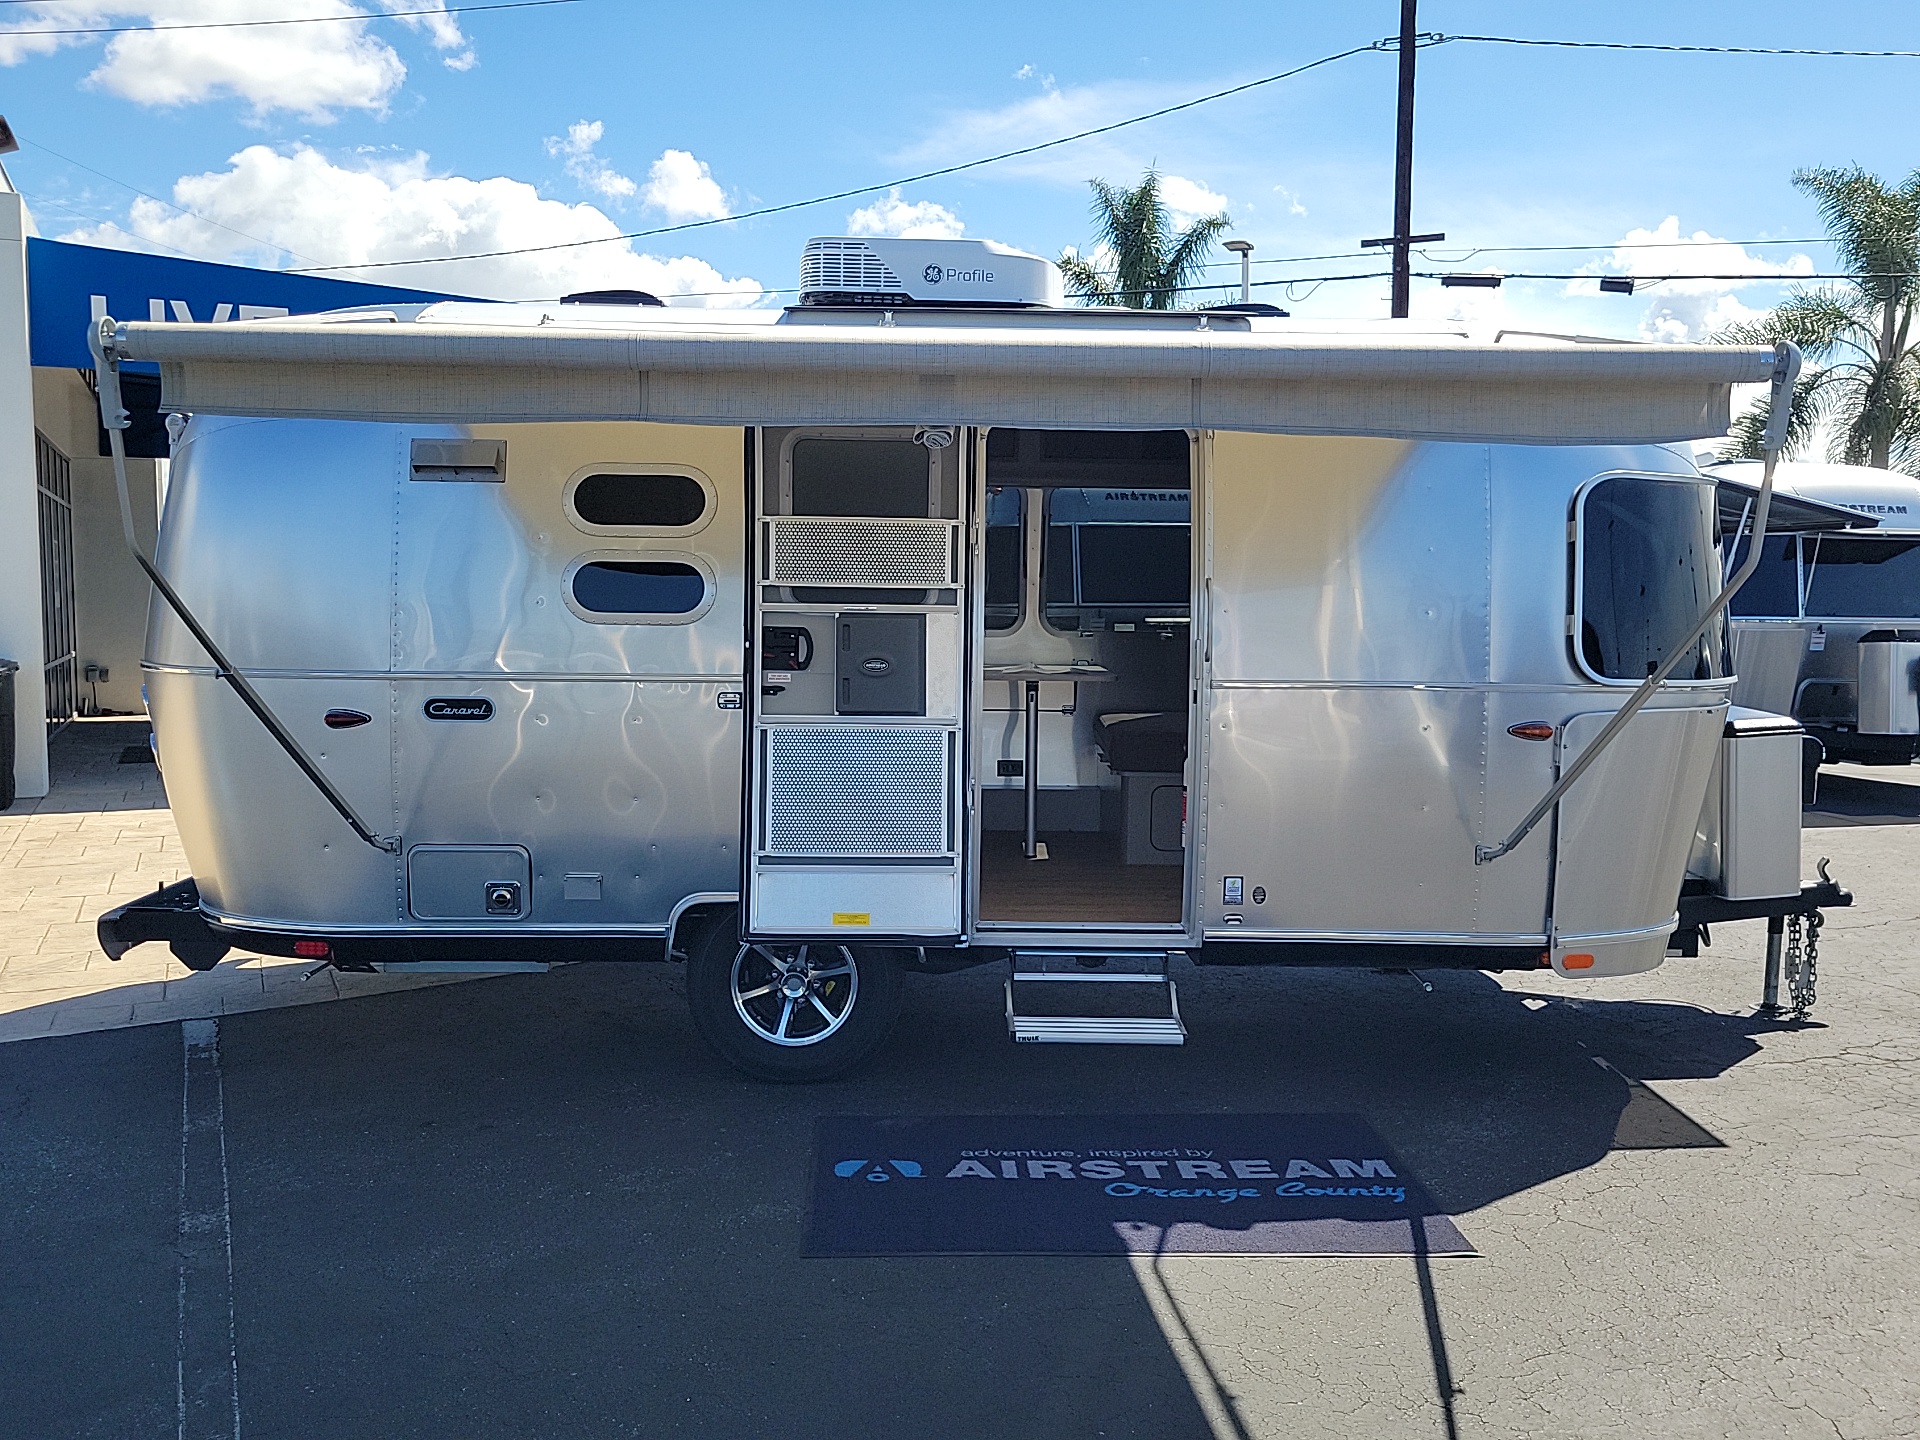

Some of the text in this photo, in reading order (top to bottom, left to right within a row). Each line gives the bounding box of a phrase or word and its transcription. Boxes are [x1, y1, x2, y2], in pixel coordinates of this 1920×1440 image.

[946, 268, 994, 283] Profile
[1104, 491, 1189, 502] AIRSTREAM
[429, 702, 490, 715] Caravel
[960, 1148, 1214, 1159] adventure, inspired by
[945, 1159, 1397, 1180] AIRSTREAM
[1104, 1181, 1406, 1203] Orange County
